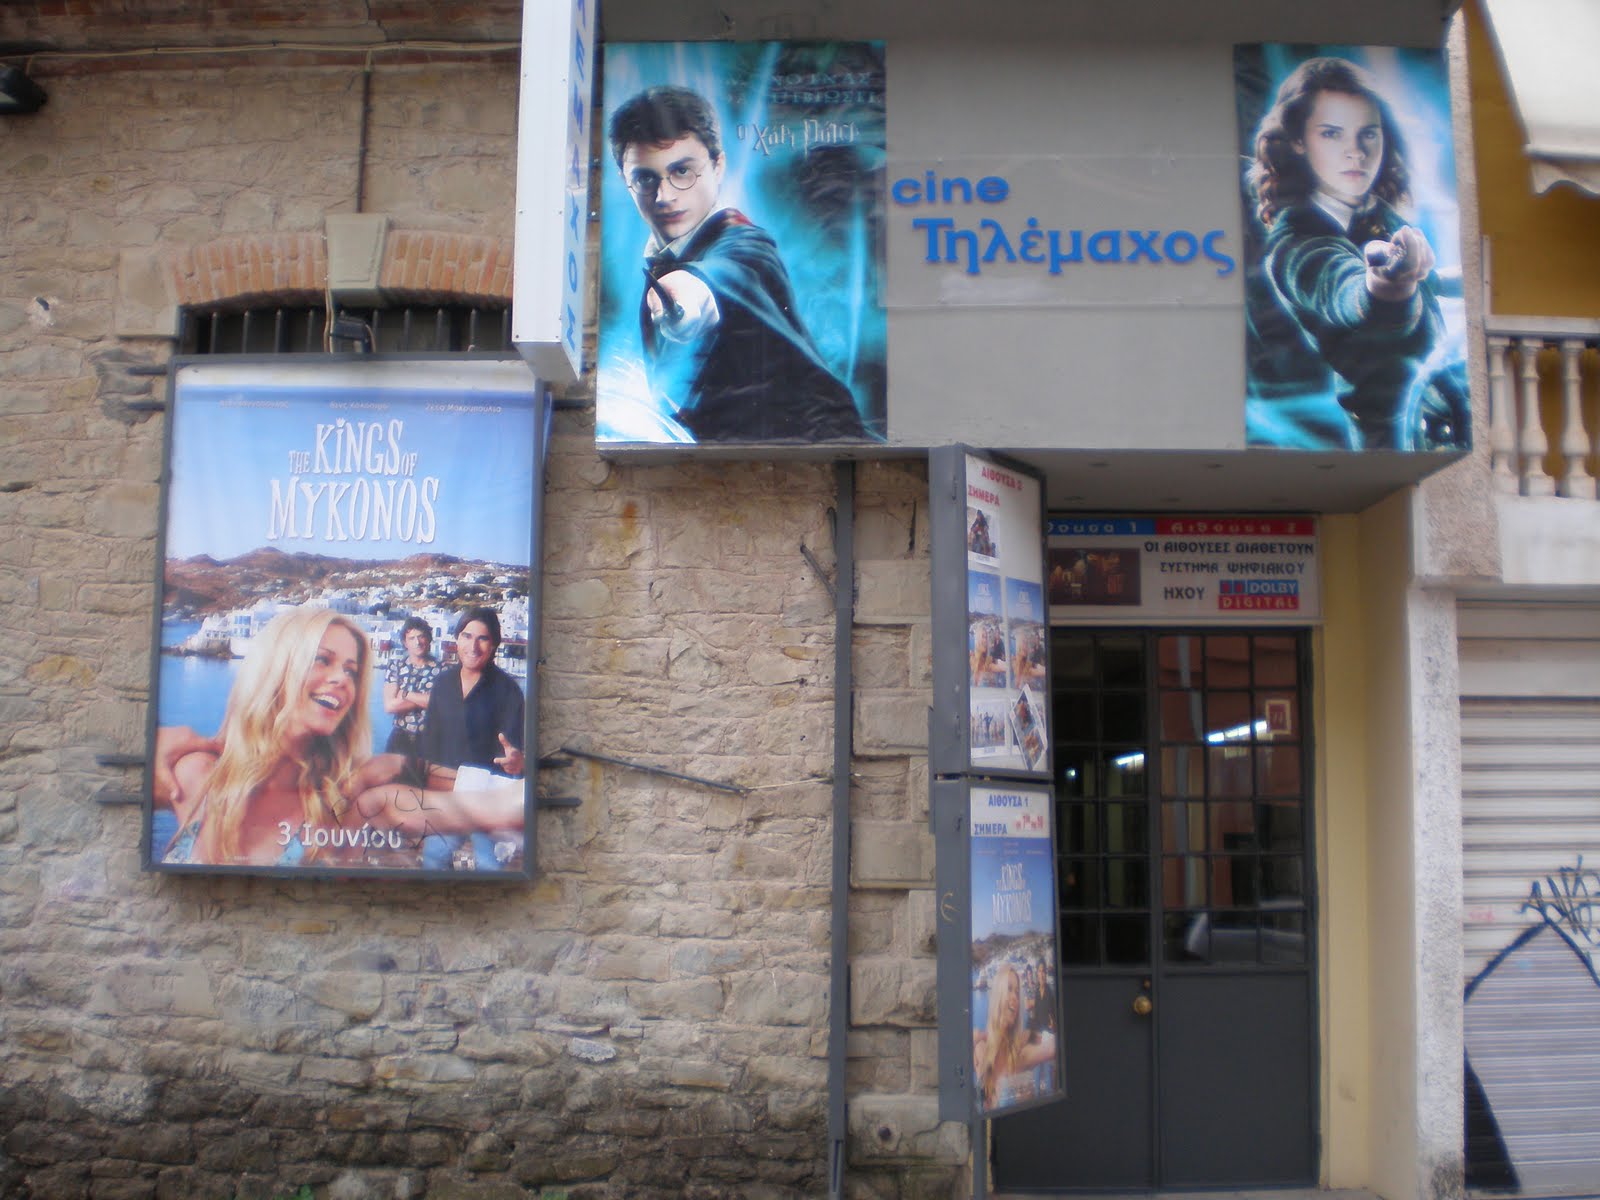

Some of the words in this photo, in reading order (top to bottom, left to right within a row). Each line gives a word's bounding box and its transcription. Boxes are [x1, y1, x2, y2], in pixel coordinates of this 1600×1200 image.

[891, 170, 1010, 205] cine
[912, 216, 1236, 276] Τηλέμαχος
[288, 449, 311, 474] THE
[313, 418, 403, 475] KINGS
[402, 451, 418, 477] OF
[265, 476, 440, 544] MYKONOS
[1144, 541, 1160, 553] ΟΙ
[1163, 541, 1231, 553] ΑΙΘΟΥΣΕΣ
[1235, 542, 1314, 555] ΔΙΑΘΕΤΟΥΝ
[1160, 561, 1219, 574] ΣΥΣΤΗΜΑ
[1227, 562, 1305, 575] ΨΗΦΙΑΚΟΥ
[1164, 586, 1206, 601] ΗΧΟΥ
[1250, 582, 1298, 595] DOLBY
[1222, 596, 1297, 609] DIGITAL
[989, 794, 1022, 808] ΑΙΘΟΥΣΑ
[277, 821, 291, 846] 3
[301, 822, 402, 850] Ιουνίου
[974, 823, 1008, 836] ΣΗΜΕΡΑ
